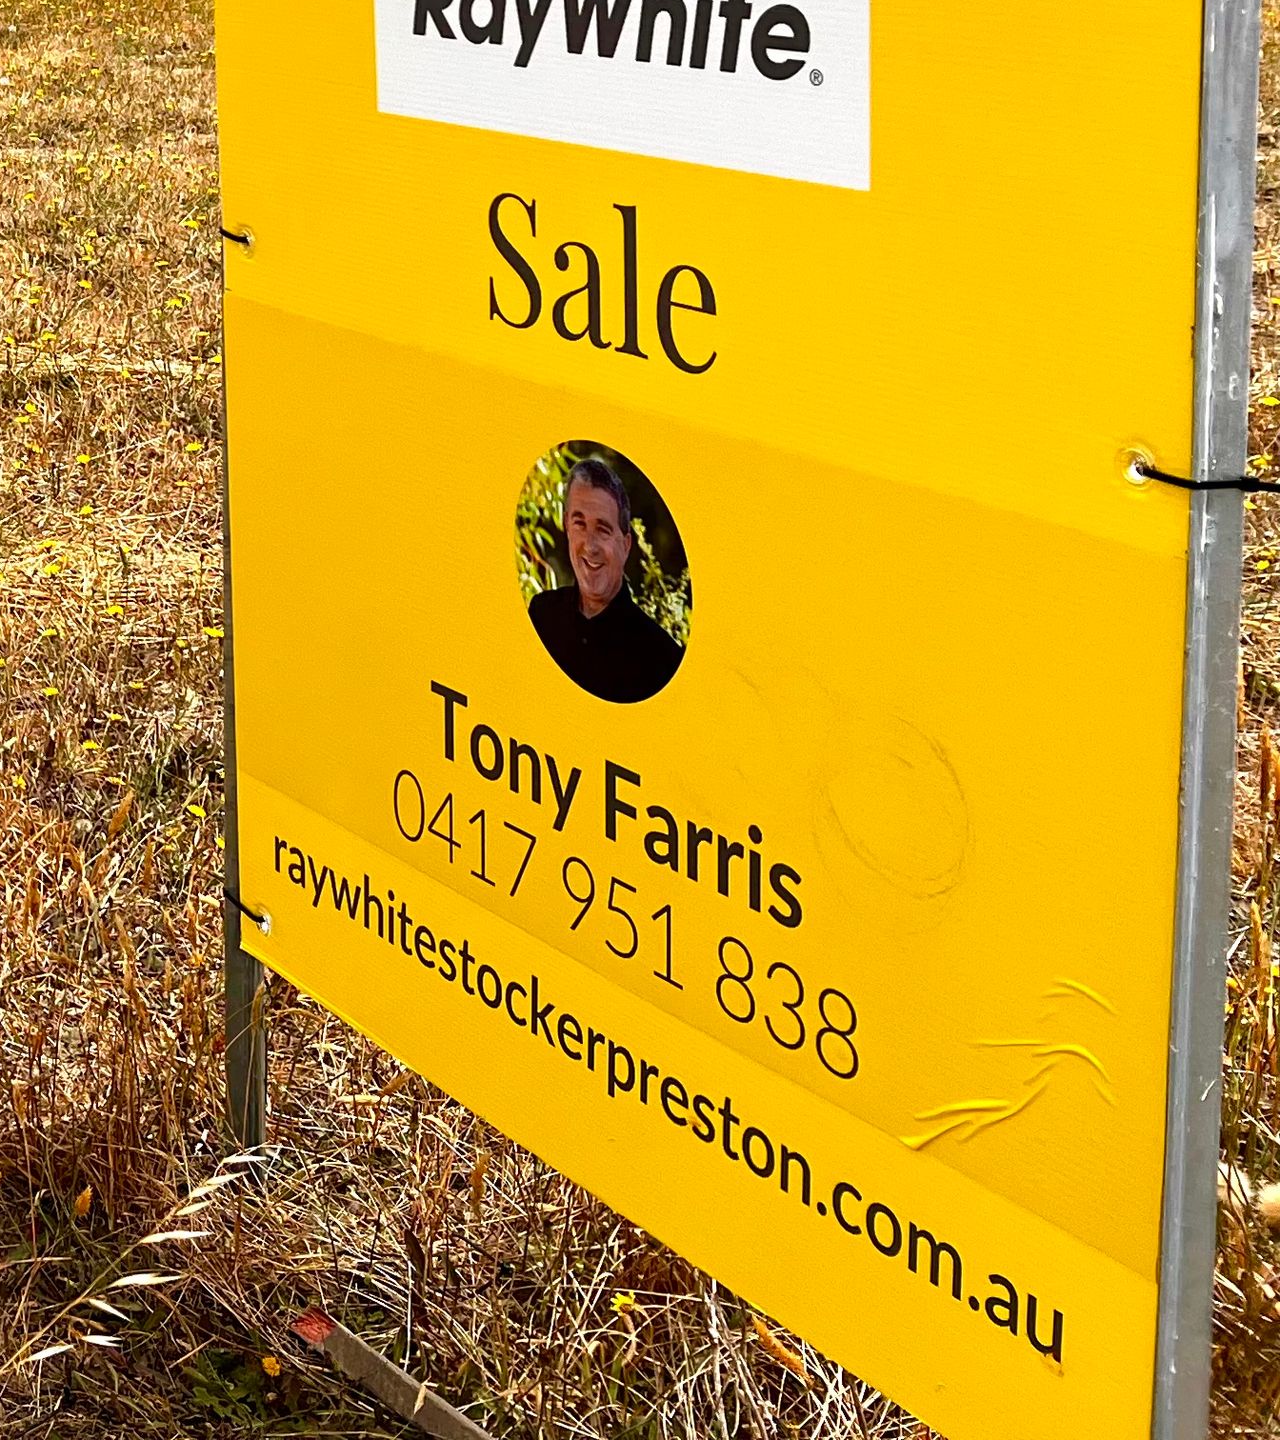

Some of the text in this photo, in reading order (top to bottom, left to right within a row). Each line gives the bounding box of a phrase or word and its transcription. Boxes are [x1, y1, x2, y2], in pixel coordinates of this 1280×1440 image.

[488, 192, 717, 375] Sale
[393, 769, 859, 1080] 0417 951 838
[430, 679, 804, 930] Tony Farris
[274, 834, 1064, 1364] raywhitestockerpreston.com.au
